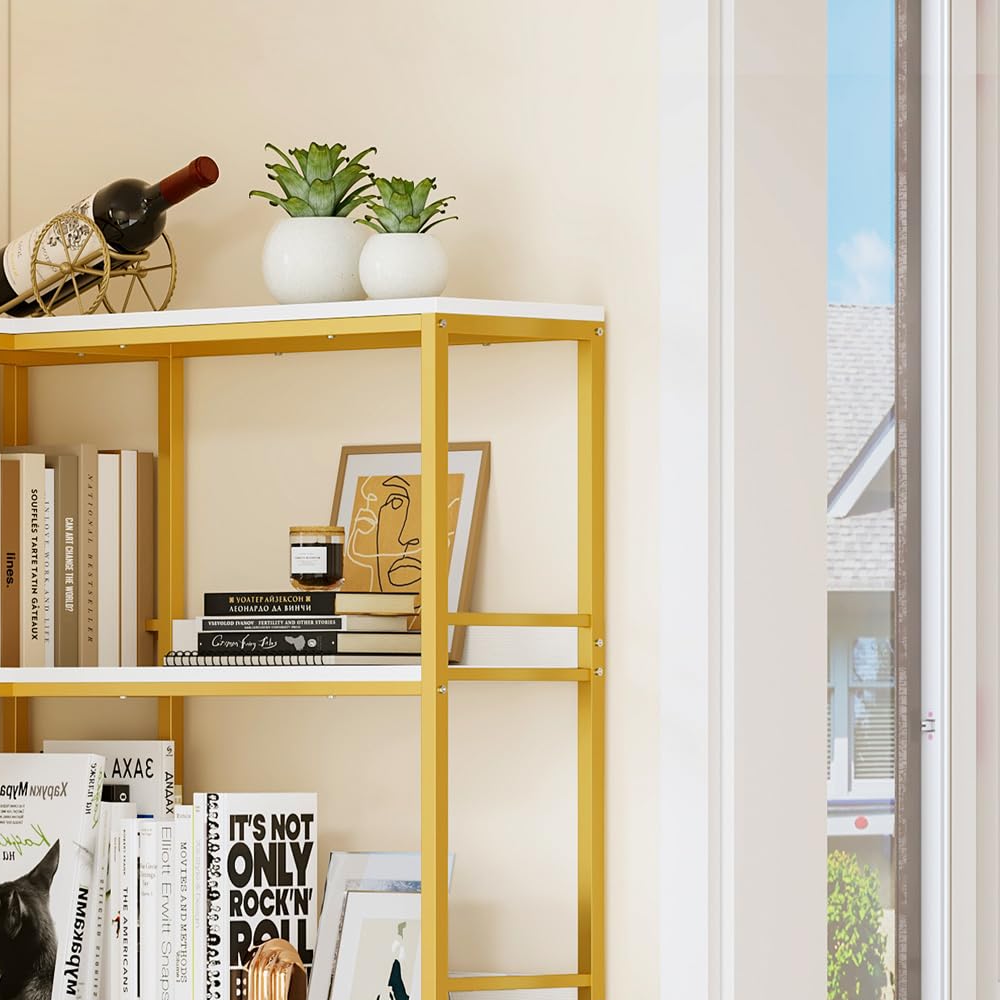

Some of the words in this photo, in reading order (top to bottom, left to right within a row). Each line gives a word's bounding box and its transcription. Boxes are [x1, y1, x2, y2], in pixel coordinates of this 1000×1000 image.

[31, 489, 40, 533] SOUFFLÉS
[65, 518, 74, 530] CAN
[65, 532, 74, 544] ART
[6, 552, 16, 588] lines.
[65, 546, 74, 571] CHANGE
[65, 573, 74, 586] THE
[65, 586, 74, 612] WORLD?
[272, 604, 282, 612] ДА
[284, 604, 312, 612] ВИНЧИ
[31, 598, 40, 640] GÂTEAUX
[230, 814, 266, 841] IT'S
[272, 814, 314, 841] NOT
[162, 826, 172, 874] Elliott
[227, 841, 314, 888] ONLY
[161, 882, 172, 933] Erwitt
[230, 888, 312, 917] ROCK'N'
